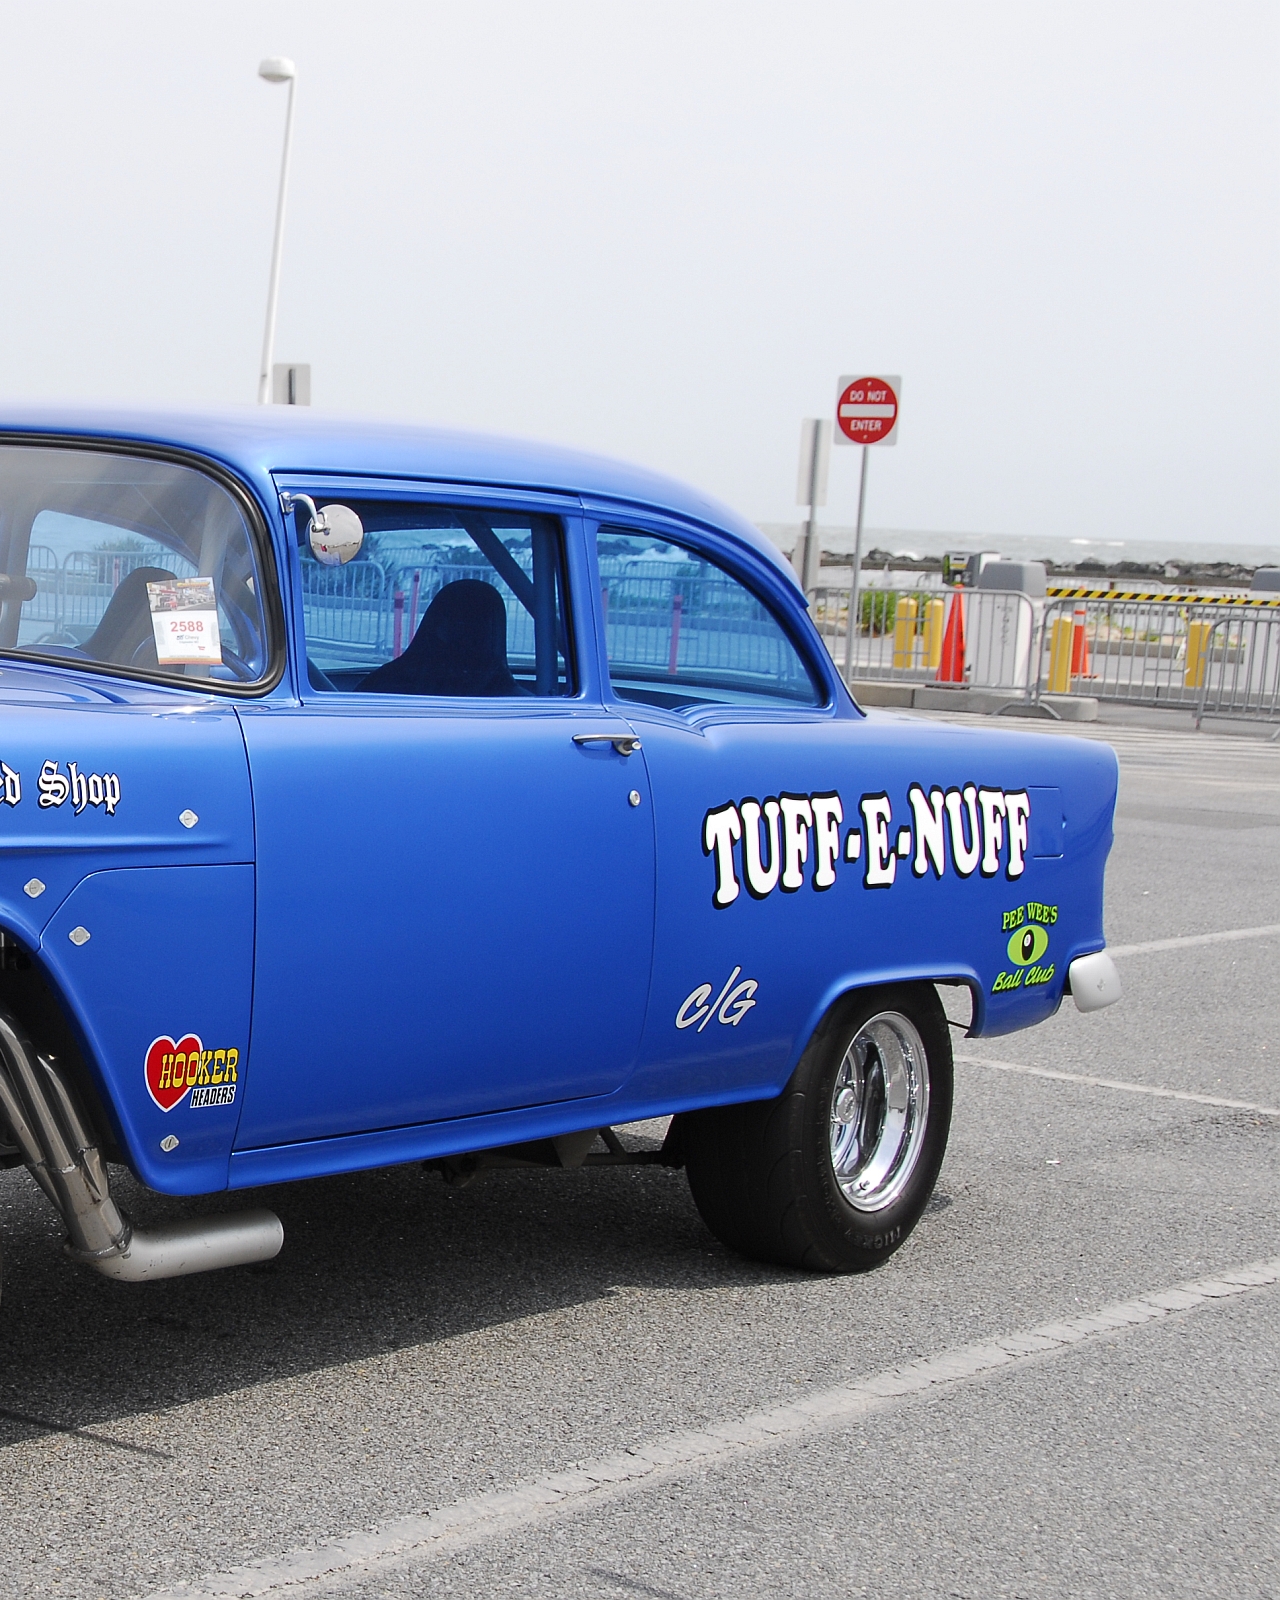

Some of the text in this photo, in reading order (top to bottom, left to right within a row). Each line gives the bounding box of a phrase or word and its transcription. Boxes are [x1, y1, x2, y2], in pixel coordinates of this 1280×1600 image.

[849, 390, 887, 402] DO NOT
[850, 419, 882, 432] ENTER
[169, 620, 204, 632] 2588
[36, 758, 122, 817] Shop
[703, 781, 1031, 910] TUFF-E-NUFF
[1001, 901, 1058, 932] PEE WEE'S
[991, 963, 1055, 994] Ball Club
[675, 965, 759, 1033] C/G
[158, 1047, 239, 1089] HOOKER
[191, 1085, 235, 1107] HEADERS
